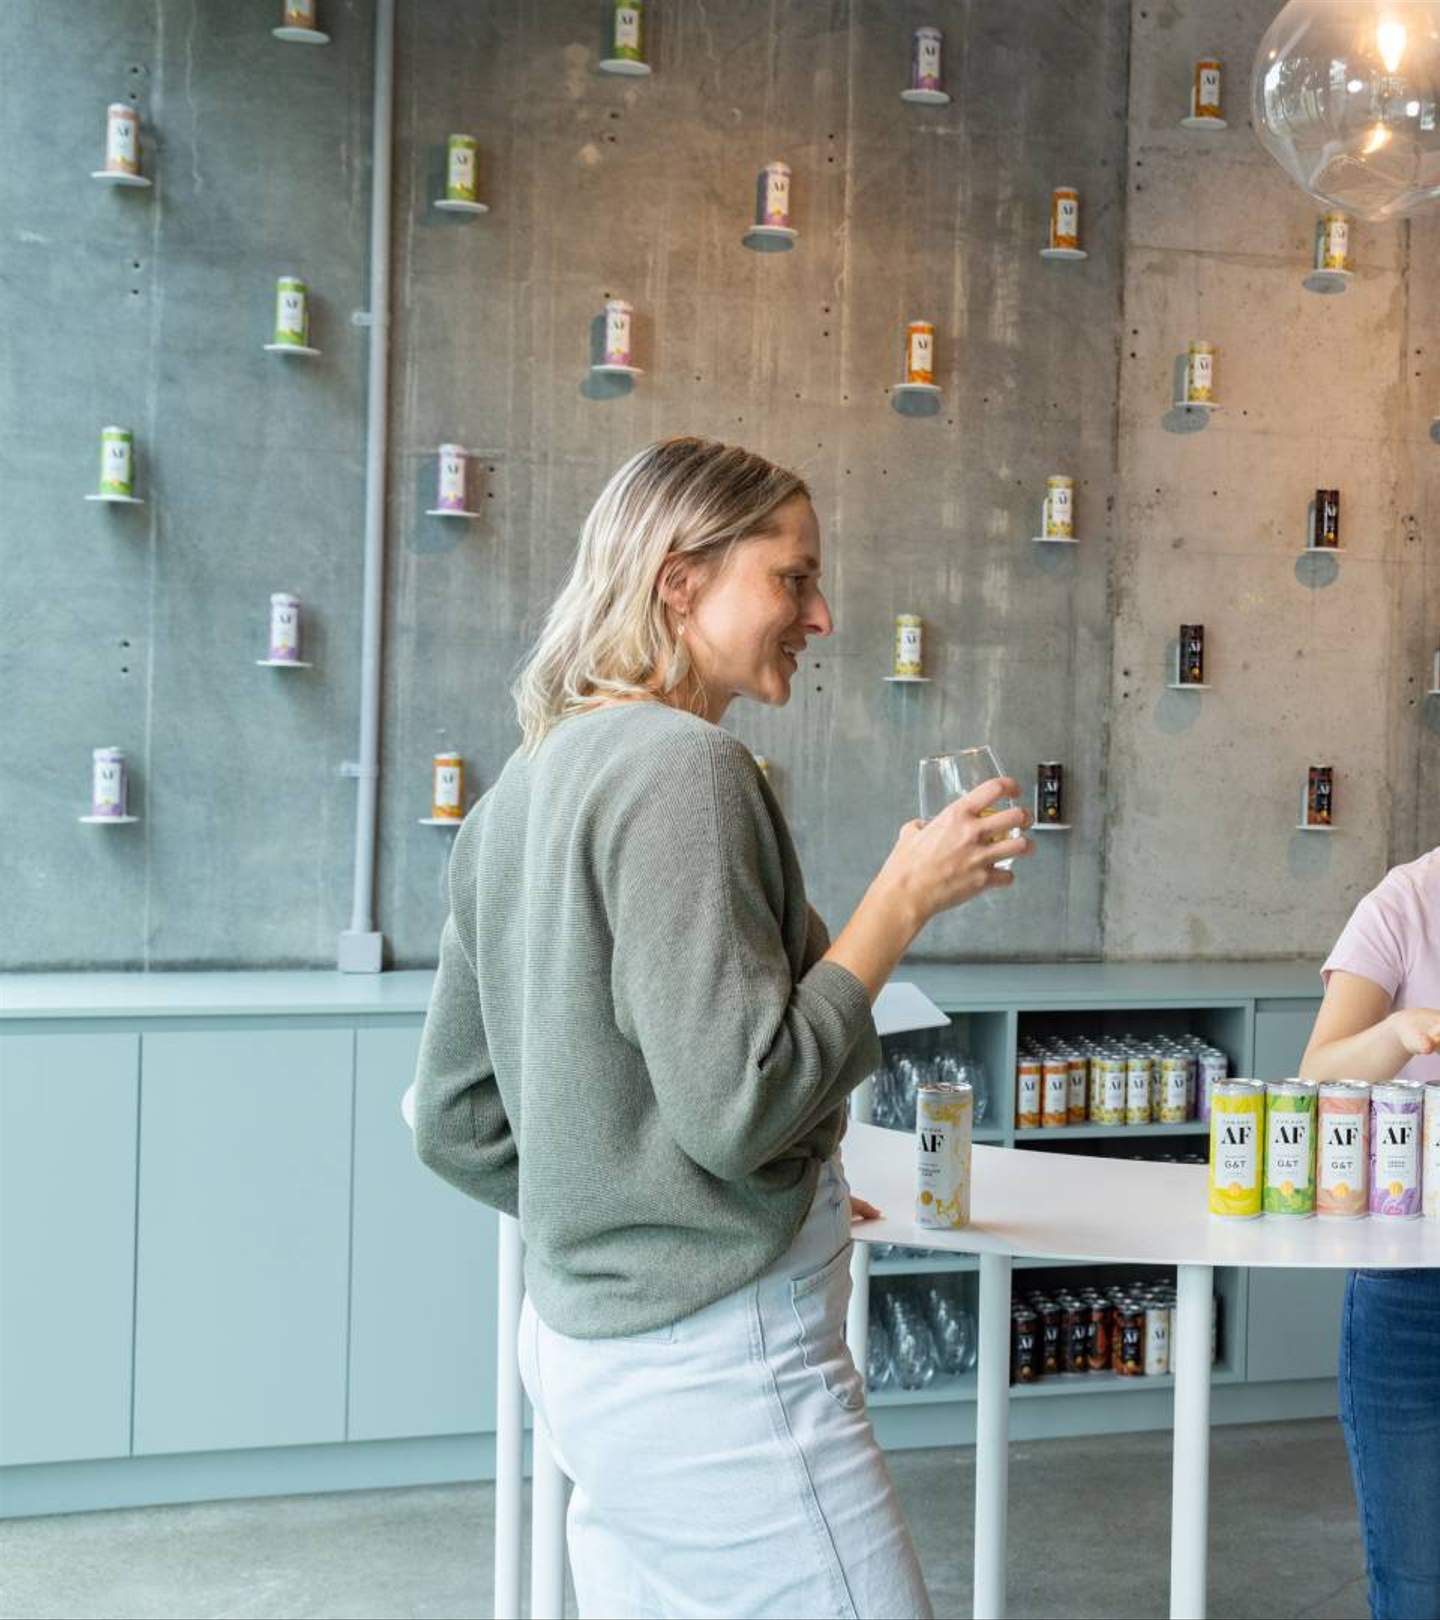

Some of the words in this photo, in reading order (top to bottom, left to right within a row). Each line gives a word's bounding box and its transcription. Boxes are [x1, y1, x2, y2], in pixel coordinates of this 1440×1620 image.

[918, 1134, 944, 1152] AF
[1221, 1126, 1251, 1144] AF
[1274, 1126, 1305, 1143] AF
[1328, 1127, 1358, 1145] AF
[1382, 1127, 1412, 1144] AF
[1225, 1160, 1247, 1168] G&T
